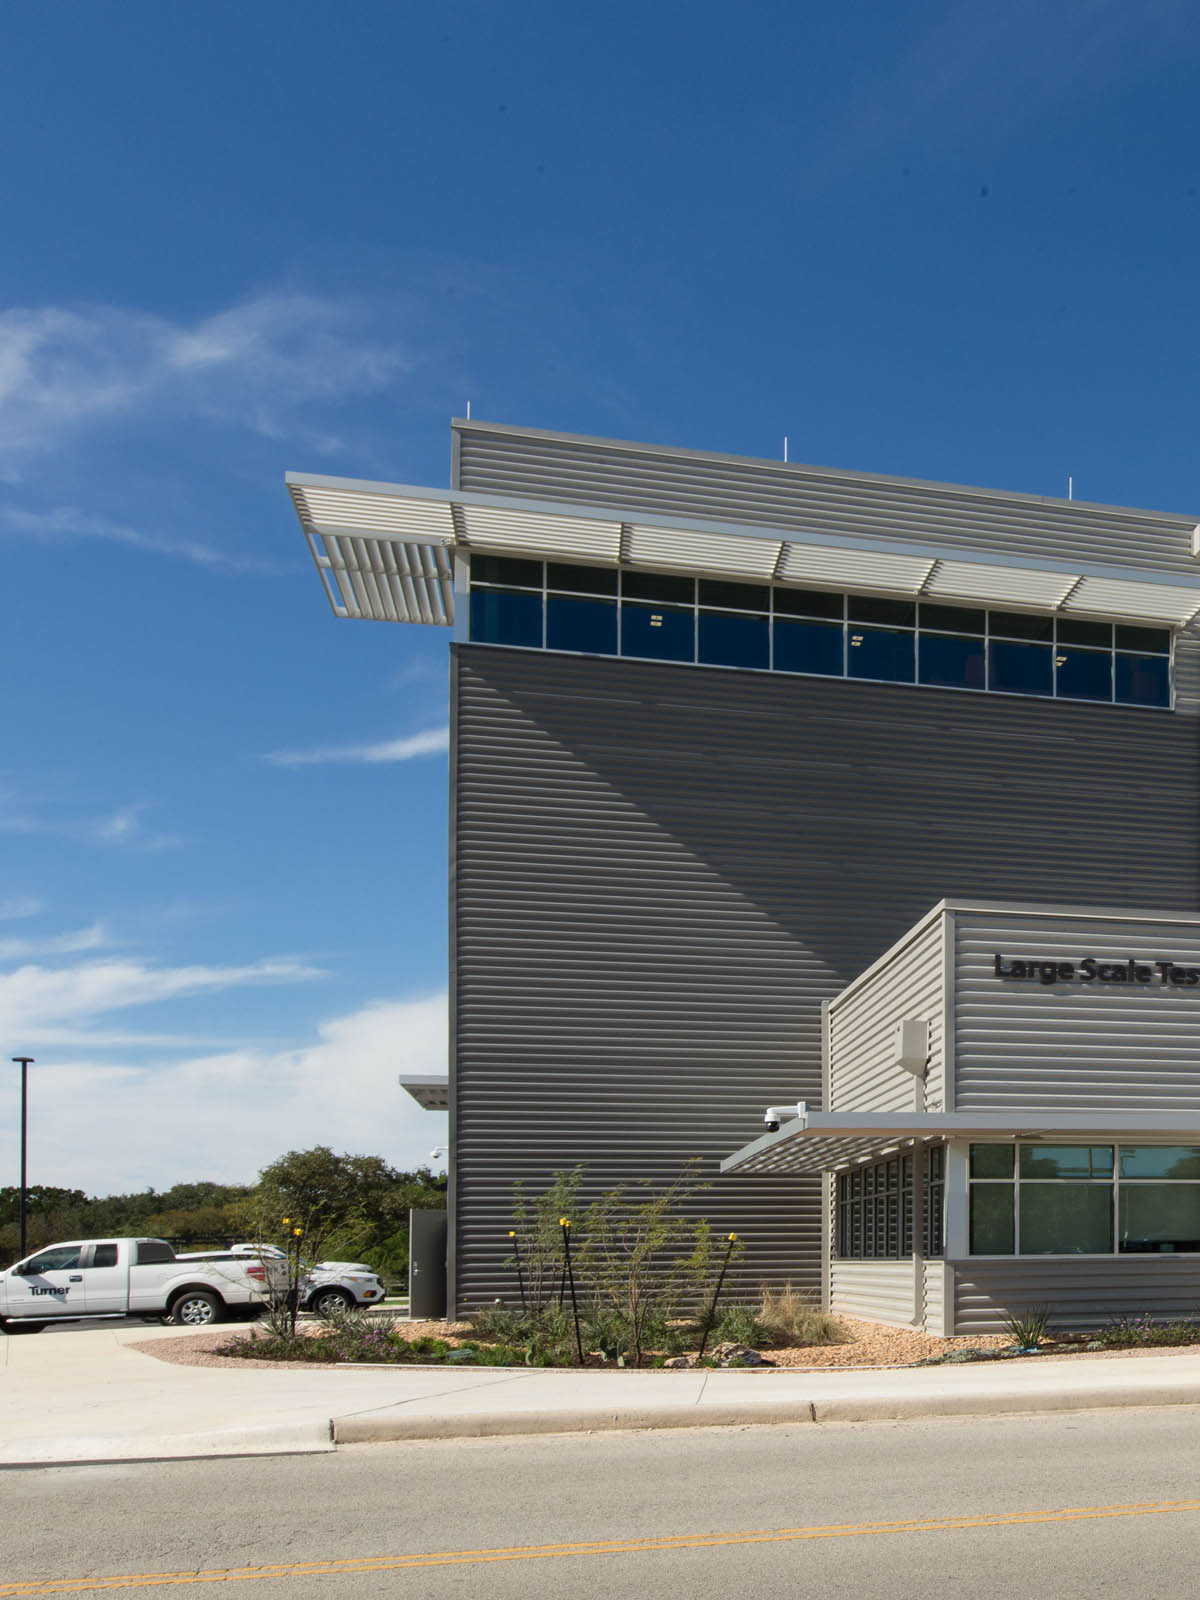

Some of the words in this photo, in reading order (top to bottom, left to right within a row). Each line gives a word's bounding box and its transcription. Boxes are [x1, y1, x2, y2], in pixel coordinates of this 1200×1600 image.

[994, 954, 1075, 985] Large
[1079, 957, 1153, 984] Scale
[28, 1286, 71, 1296] Turner
